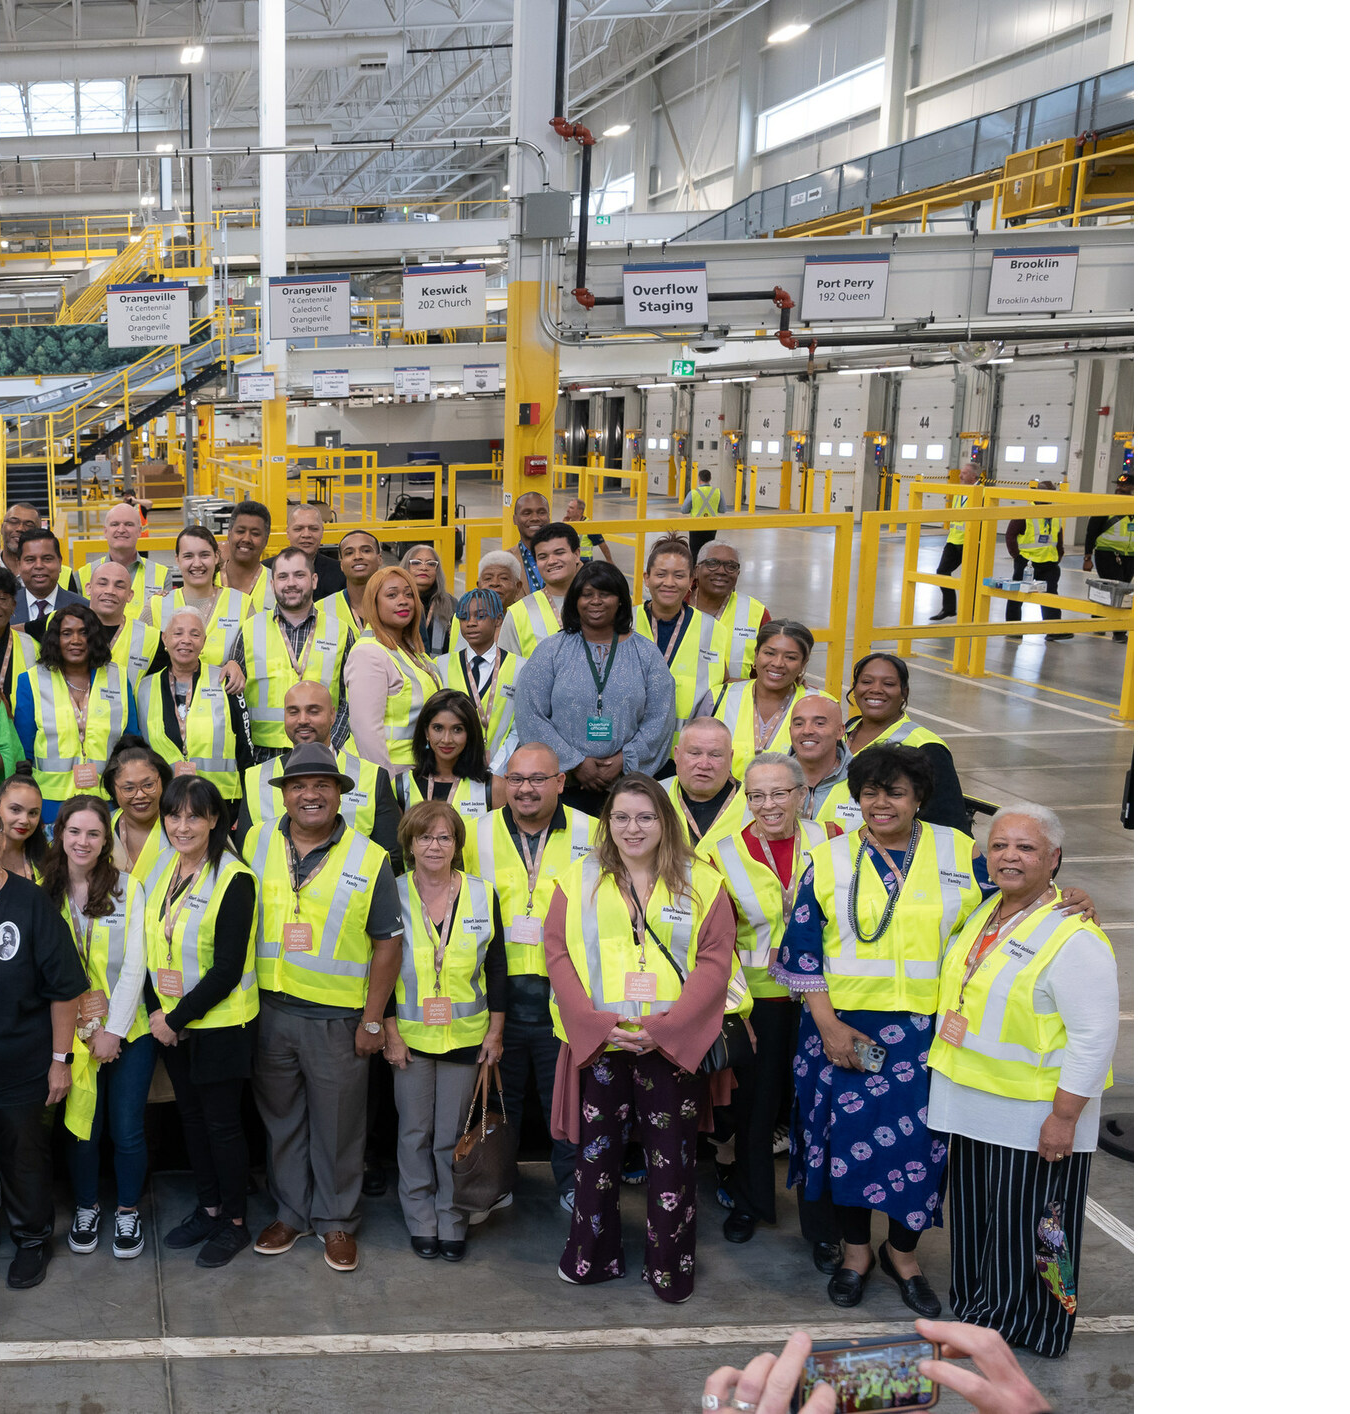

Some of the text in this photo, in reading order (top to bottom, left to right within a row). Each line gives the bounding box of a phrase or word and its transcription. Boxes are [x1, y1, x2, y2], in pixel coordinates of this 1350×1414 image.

[1011, 259, 1059, 269] Brooklin
[1017, 273, 1049, 281] 2 Price
[817, 279, 874, 289] Port Perry
[282, 285, 337, 296] Orangeville
[421, 284, 467, 297] Keswick
[633, 284, 698, 296] Overflow
[120, 293, 176, 304] Orangeville
[819, 292, 870, 301] 192 Queen
[418, 298, 471, 309] 202 Church
[639, 301, 693, 313] Staging
[290, 315, 331, 324] Orangeville
[128, 324, 170, 332] Orangeville
[705, 419, 710, 428] 47
[763, 418, 769, 428] 46
[833, 418, 841, 428] 45
[920, 416, 929, 428] 44
[1028, 414, 1040, 428] 43
[759, 486, 765, 495] 46
[342, 871, 354, 879] Albert
[346, 880, 358, 888] Family
[1009, 940, 1035, 955] Albert Jackson
[1010, 949, 1023, 958] Family
